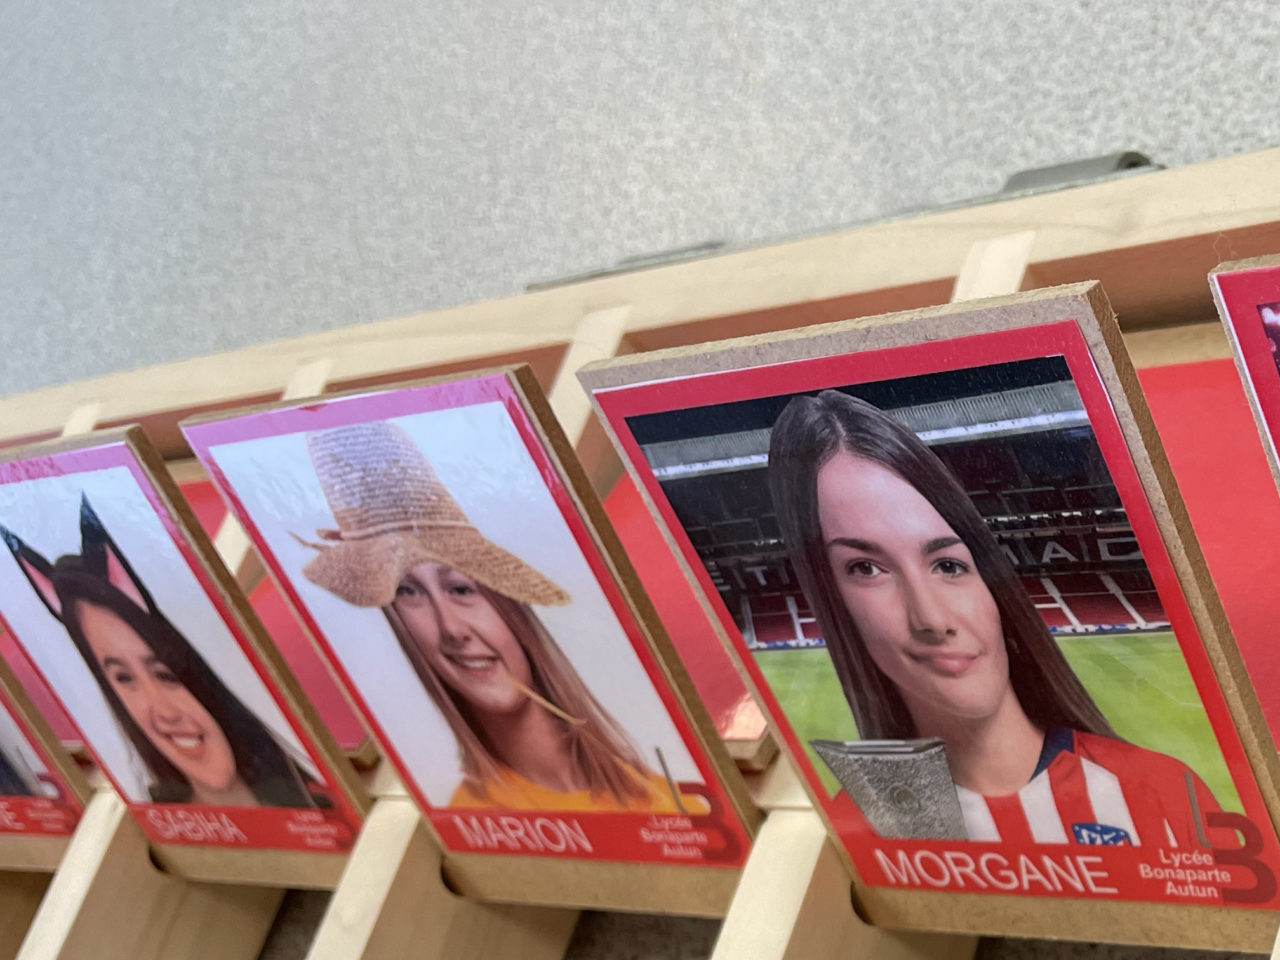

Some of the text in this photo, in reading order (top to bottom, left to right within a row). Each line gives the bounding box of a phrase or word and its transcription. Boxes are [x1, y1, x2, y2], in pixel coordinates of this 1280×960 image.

[146, 807, 248, 842] SABIHA
[452, 814, 593, 853] MARION
[874, 848, 1118, 893] MORGANE
[1159, 848, 1214, 867] Lycée
[1139, 863, 1232, 883] Bonaparte
[1166, 881, 1218, 898] Autun
